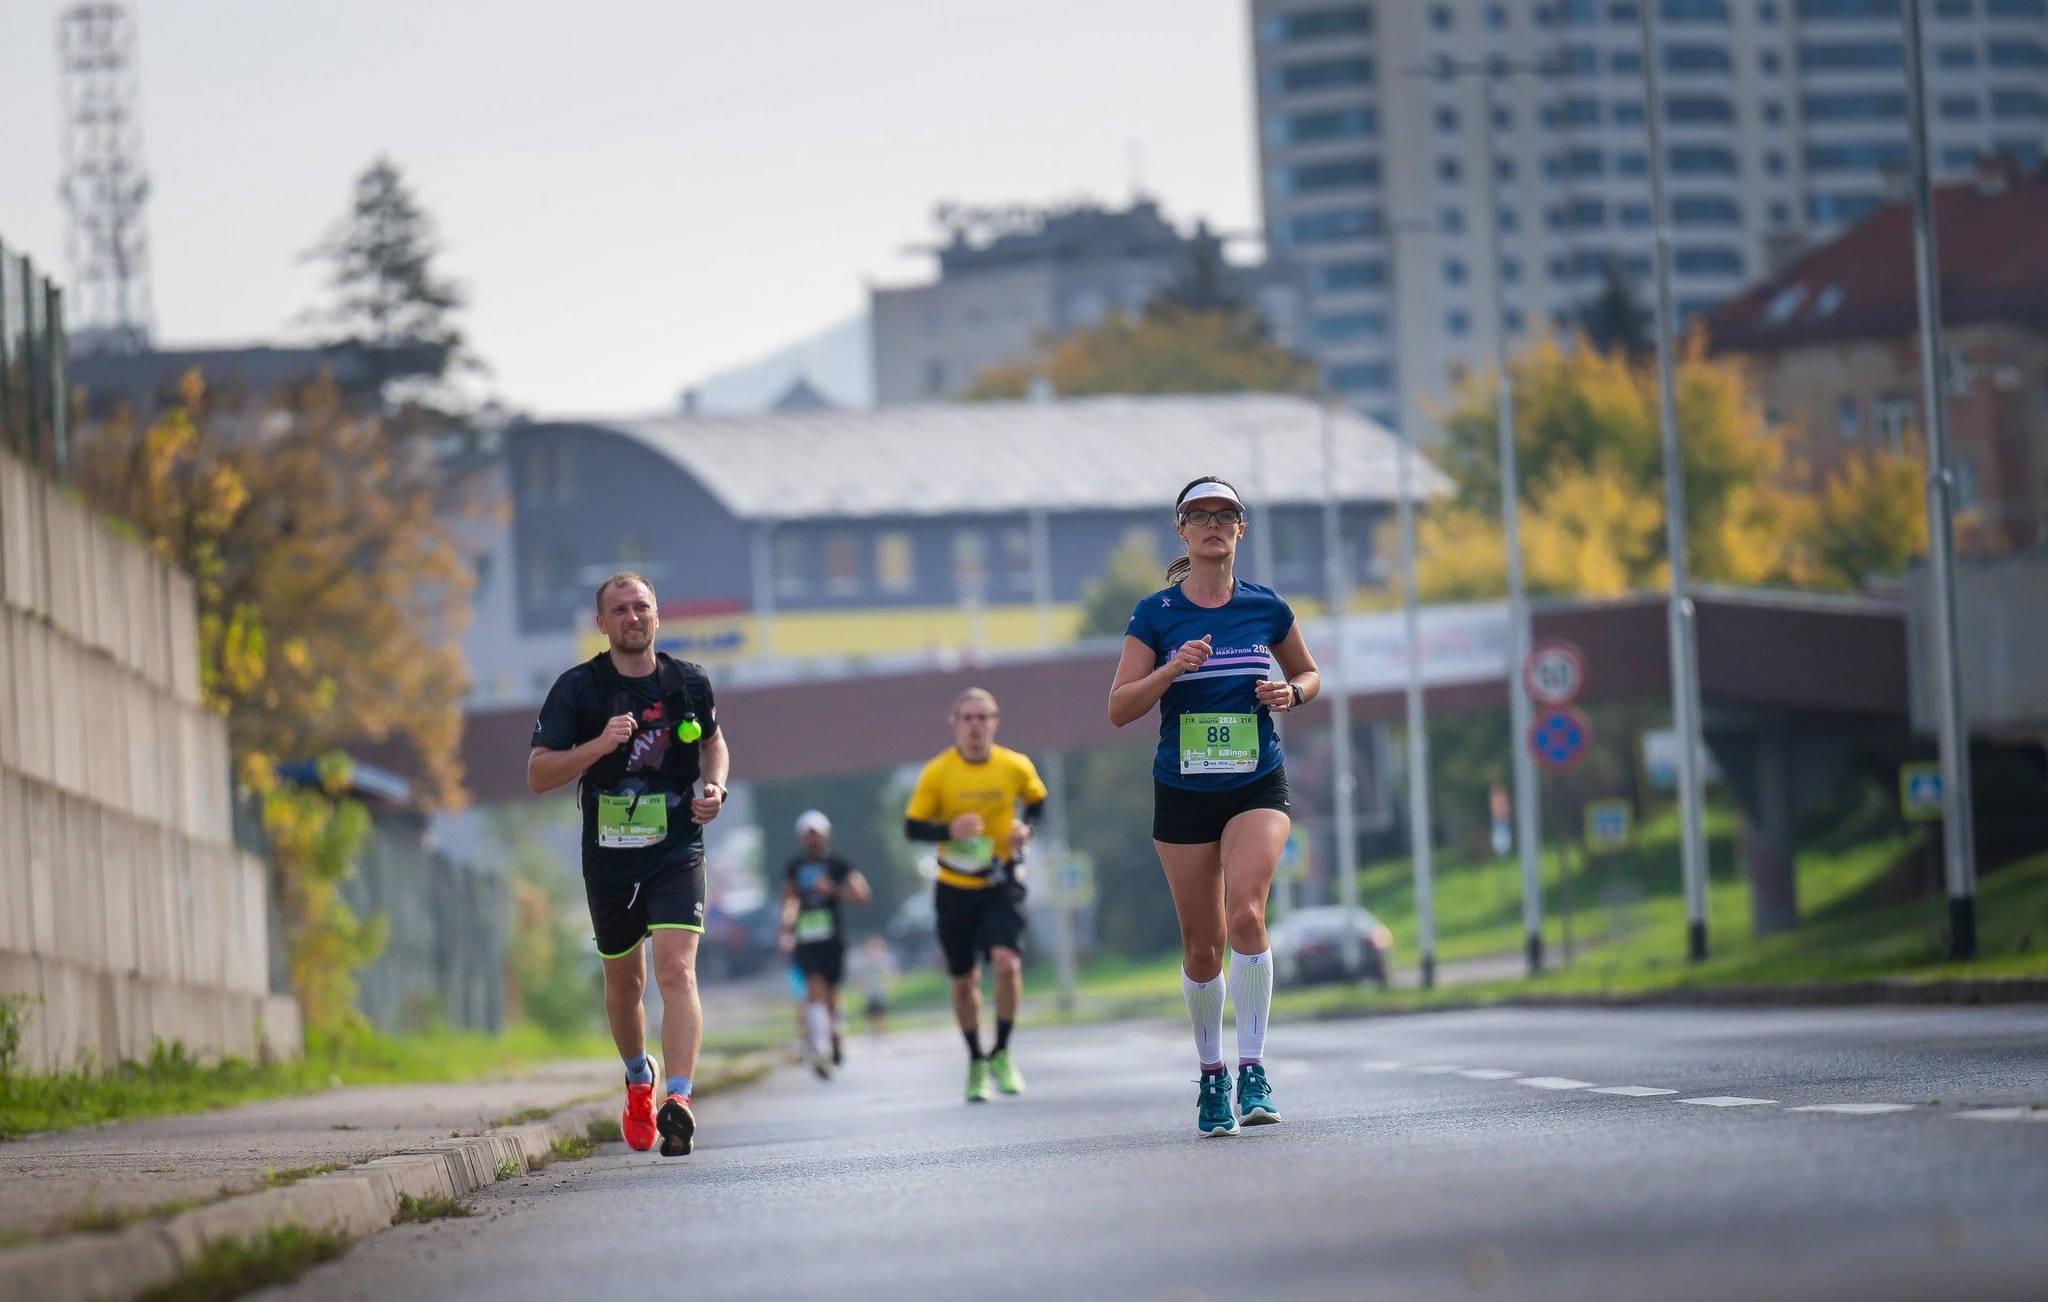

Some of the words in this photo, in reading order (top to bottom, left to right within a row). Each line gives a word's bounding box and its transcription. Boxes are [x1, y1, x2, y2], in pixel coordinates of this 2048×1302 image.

[1219, 716, 1238, 724] 2024
[1207, 726, 1230, 743] 88
[1226, 749, 1248, 757] Bingo
